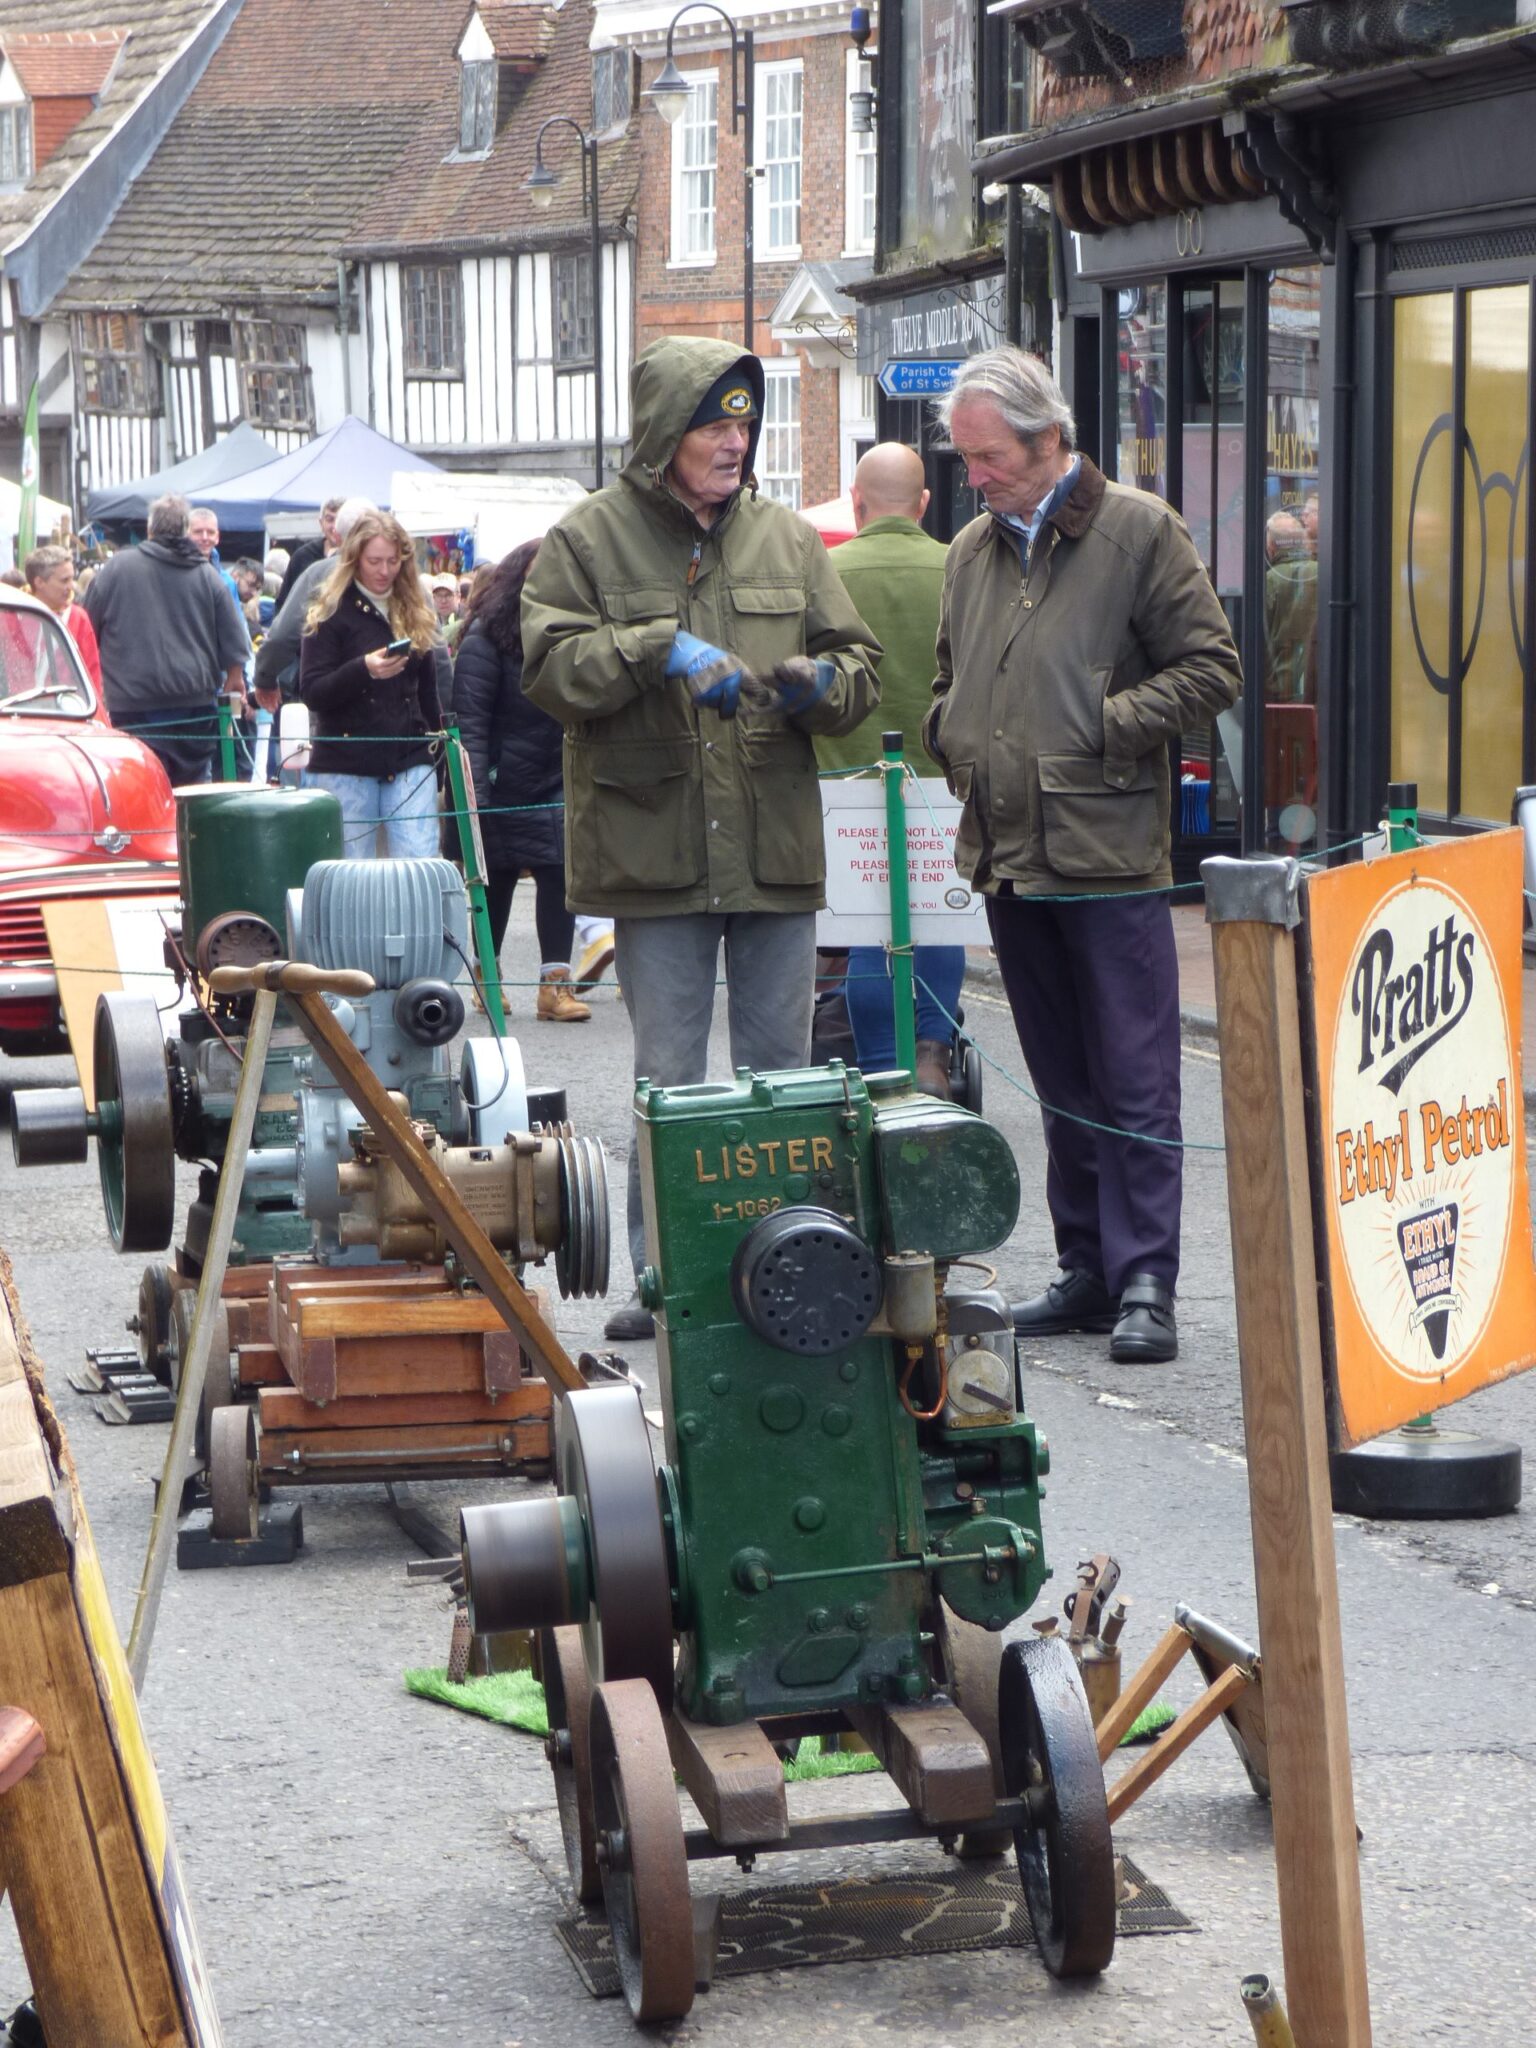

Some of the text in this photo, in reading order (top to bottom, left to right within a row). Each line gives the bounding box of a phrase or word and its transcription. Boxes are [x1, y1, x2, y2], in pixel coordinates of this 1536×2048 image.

[892, 301, 980, 354] TWELVE MIDDLE ROW
[901, 367, 935, 377] Parish
[901, 379, 912, 389] of
[917, 379, 929, 389] St
[1121, 437, 1165, 477] THUR
[1273, 432, 1313, 473] HAYES
[838, 828, 879, 837] PLEASE
[905, 828, 926, 837] NOT
[931, 828, 959, 837] LEAV
[860, 841, 877, 850] VIA
[907, 841, 944, 850] ROPES
[862, 873, 874, 882] AT
[922, 873, 944, 882] END
[923, 860, 954, 869] EXITS
[1352, 914, 1475, 1080] Pratts
[1336, 1077, 1510, 1206] Ethyl Petrol
[695, 1136, 835, 1183] LISTER
[1419, 1197, 1435, 1209] WITH
[1402, 1210, 1456, 1262] ETHYL
